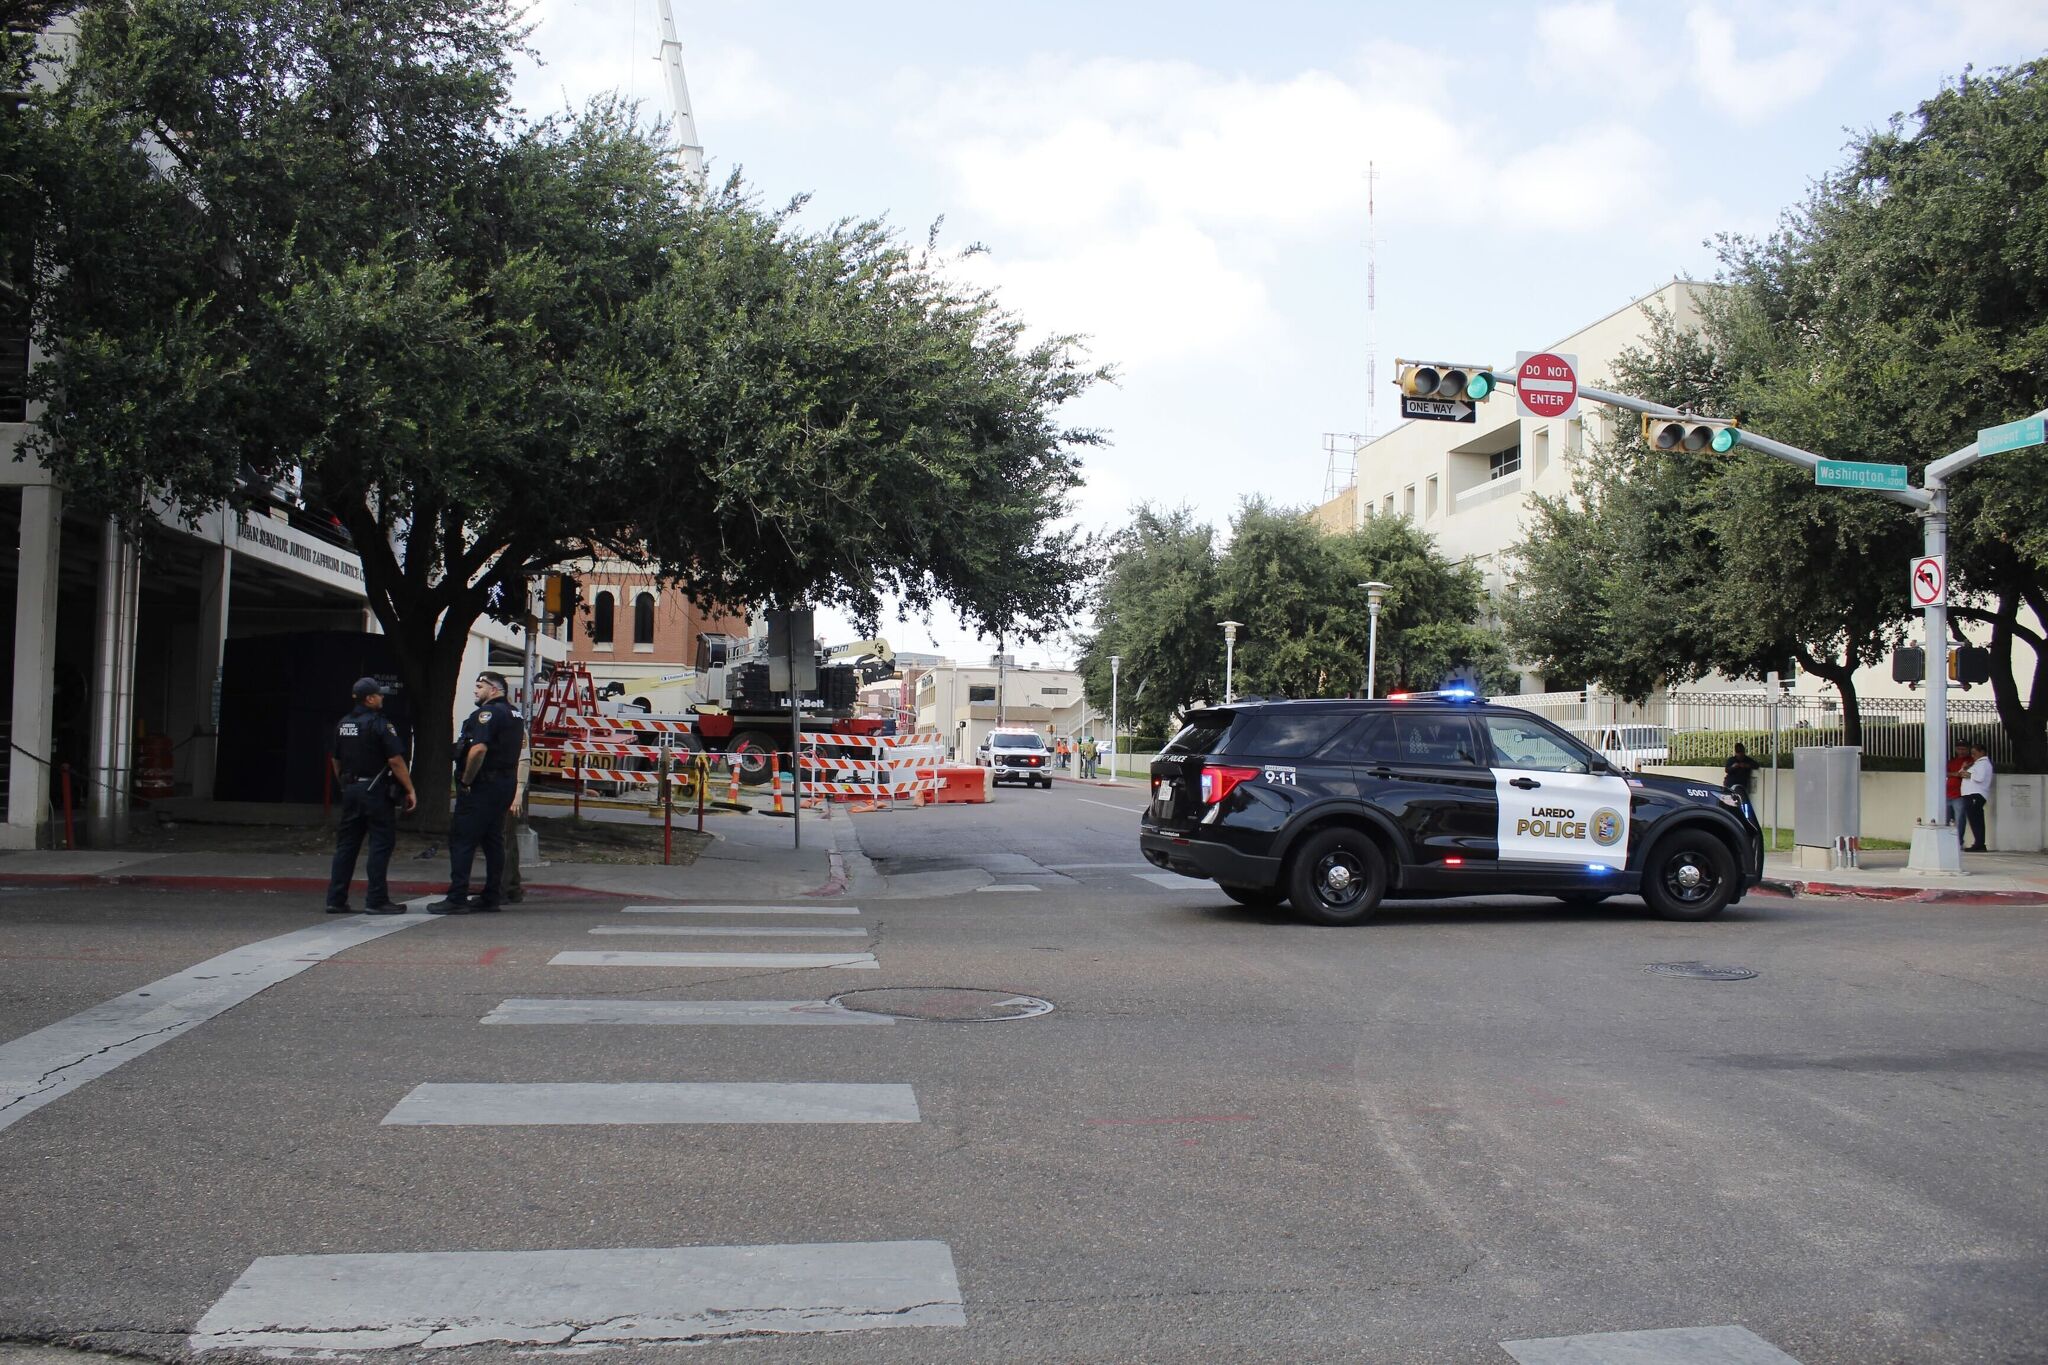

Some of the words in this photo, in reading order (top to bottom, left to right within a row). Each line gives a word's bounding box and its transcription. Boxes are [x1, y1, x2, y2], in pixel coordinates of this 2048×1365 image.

[1526, 365, 1540, 376] DO
[1547, 366, 1568, 378] NOT
[1530, 394, 1564, 406] ENTER
[1410, 402, 1430, 412] ONE
[1433, 404, 1454, 414] WAY
[1820, 466, 1884, 485] Washington
[259, 529, 288, 554] SENATOR
[290, 542, 312, 562] JUDITH
[340, 560, 360, 580] JUSTICE
[780, 698, 824, 708] Lik-Belt
[340, 727, 358, 736] POLICE
[1167, 755, 1188, 763] POLICE
[1686, 788, 1708, 797] 5007
[1532, 807, 1575, 818] LAREDO
[1516, 819, 1587, 840] POLICE
